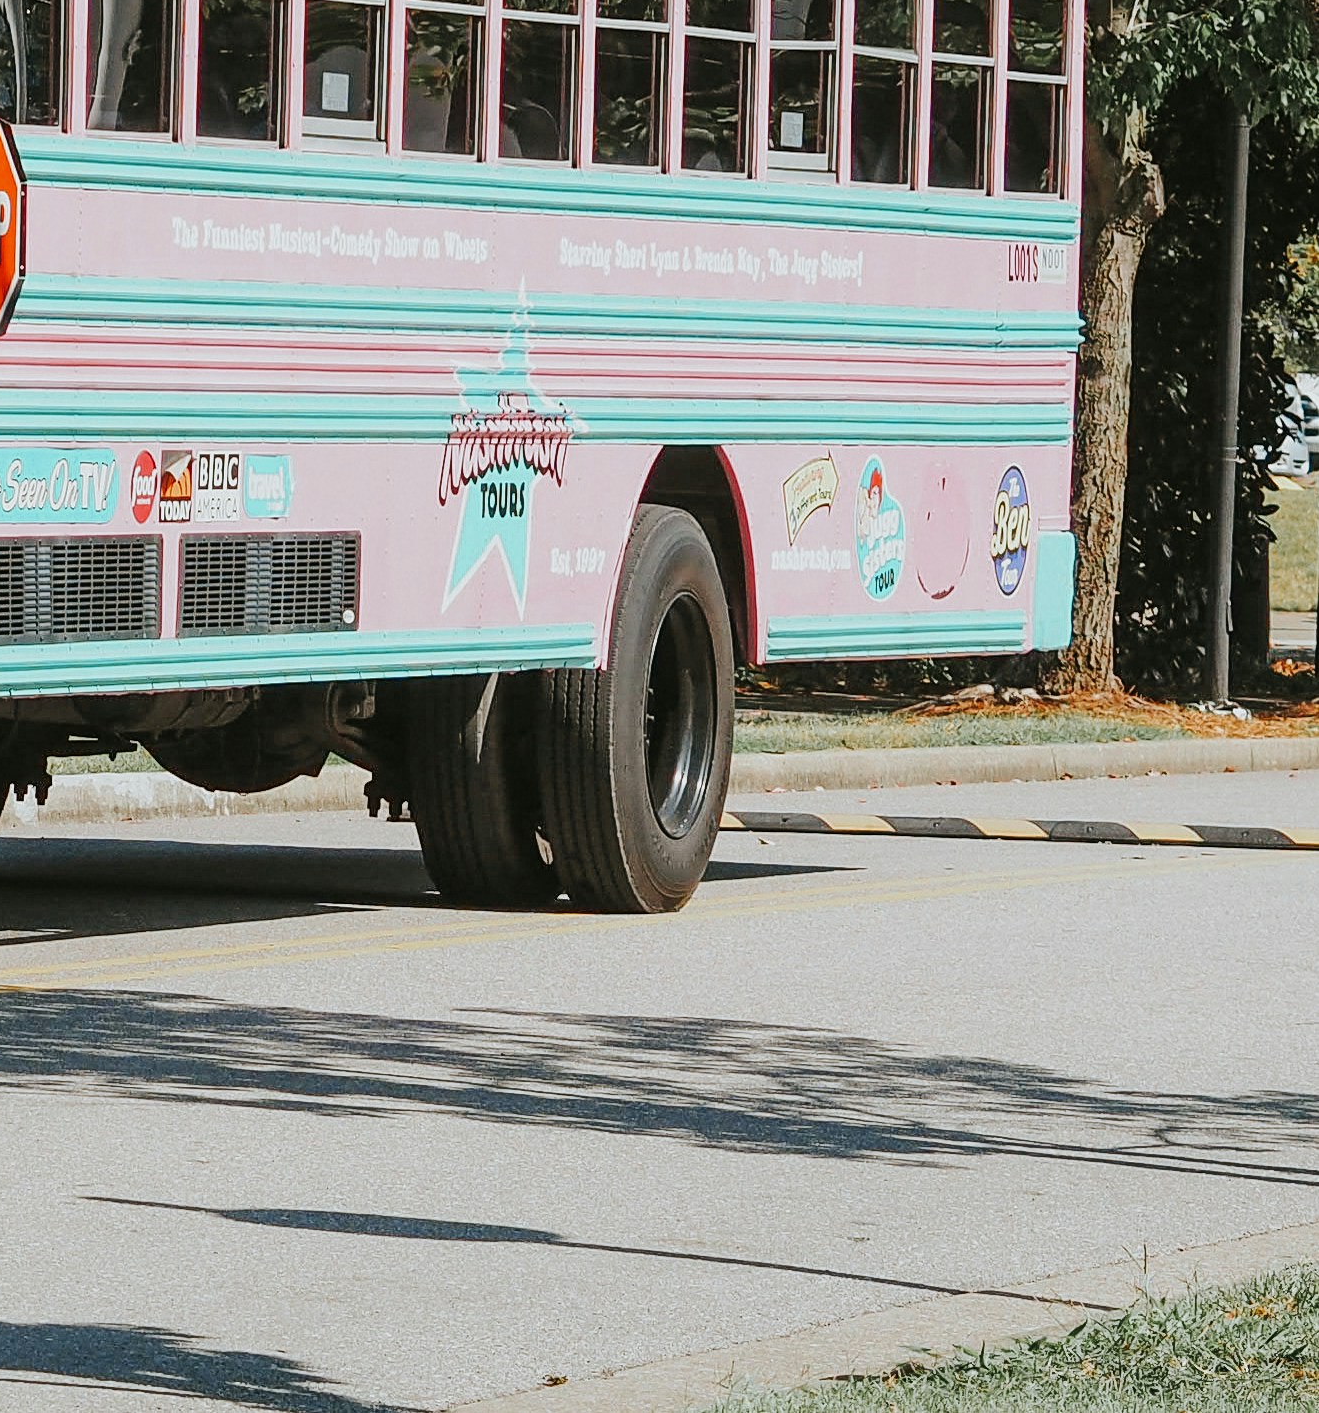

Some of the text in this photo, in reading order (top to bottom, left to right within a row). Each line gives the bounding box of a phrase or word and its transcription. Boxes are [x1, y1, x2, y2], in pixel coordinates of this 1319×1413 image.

[171, 216, 199, 249] The
[202, 219, 266, 254] Funniest
[384, 227, 420, 259] Show
[422, 235, 441, 259] on
[443, 230, 490, 265] Wheels
[560, 236, 612, 277] Starring
[615, 239, 647, 271] Sheri
[650, 242, 680, 279] Lynn
[682, 246, 692, 272] &
[694, 245, 735, 275] Brenda
[768, 247, 789, 276] The
[790, 248, 819, 286] Jugg
[821, 249, 864, 287] Sisters!
[2, 457, 49, 512] Seen
[49, 457, 79, 512] On
[131, 465, 158, 507] food
[198, 454, 240, 490] BBC
[159, 500, 192, 522] TODAY
[197, 497, 238, 519] AMERICA
[480, 482, 526, 518] TOURS
[875, 568, 895, 594] TOUR
